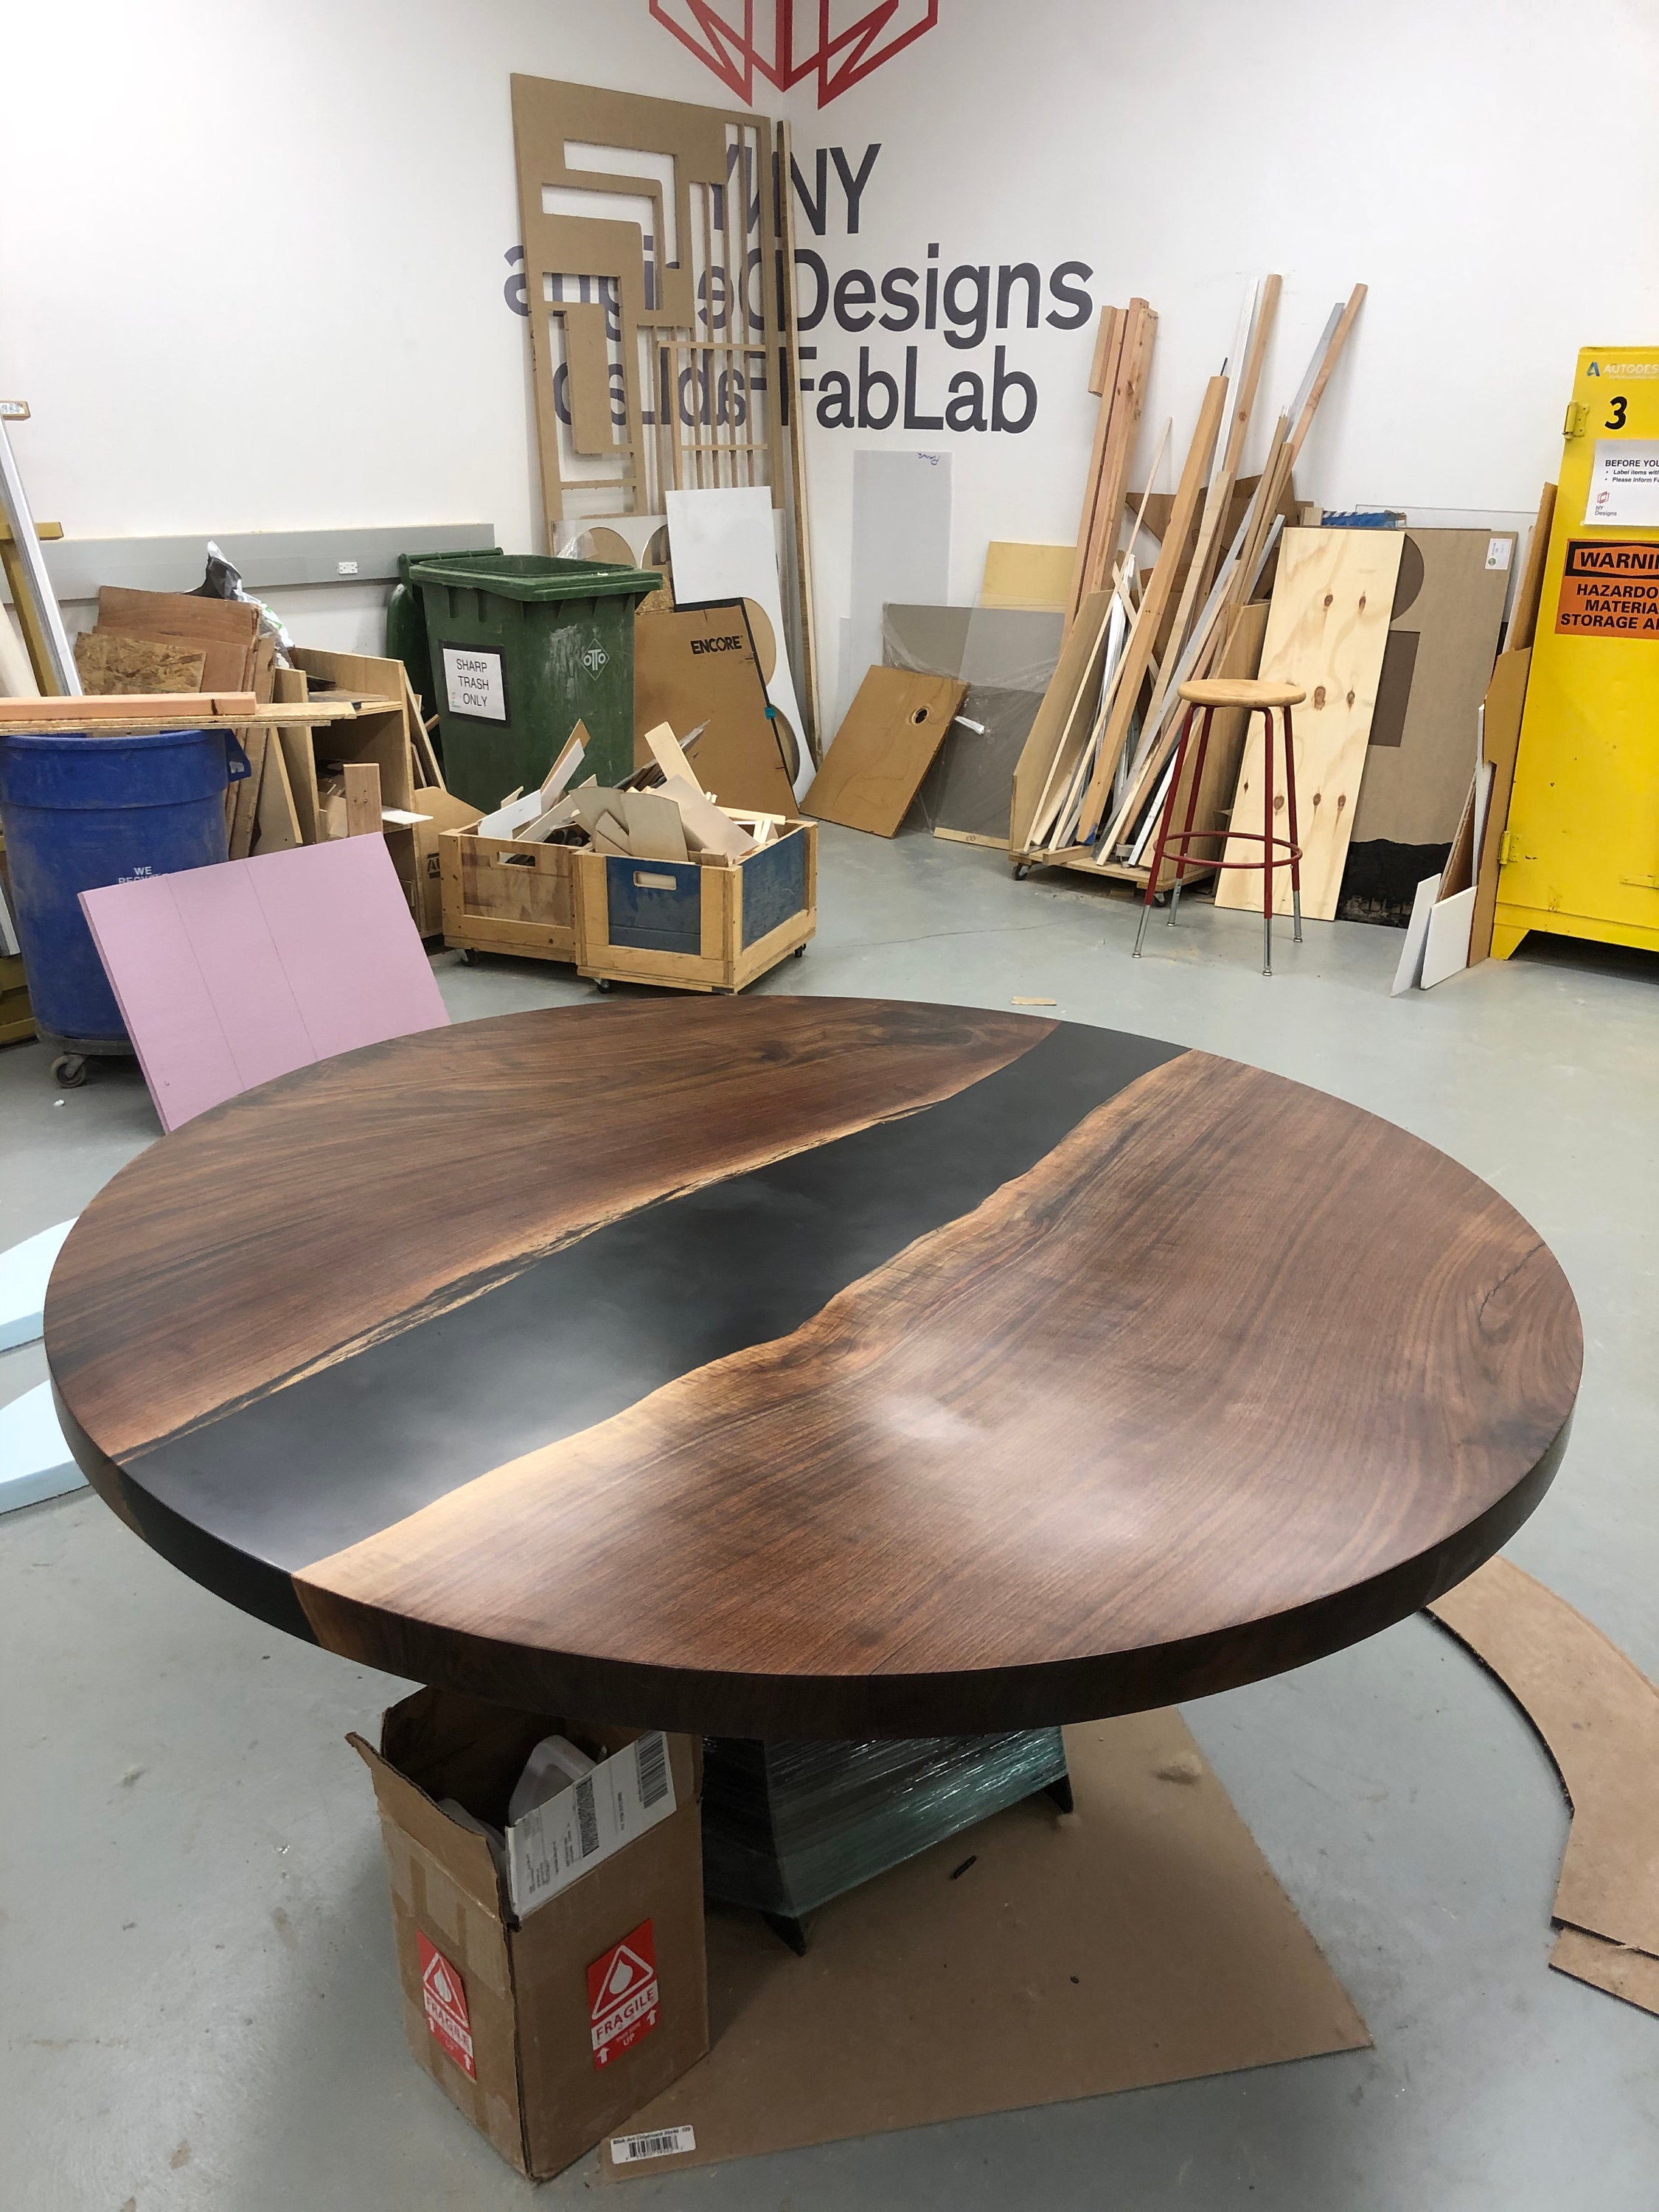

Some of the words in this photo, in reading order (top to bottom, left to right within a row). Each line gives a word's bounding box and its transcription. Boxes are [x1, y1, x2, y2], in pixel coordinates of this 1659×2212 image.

[773, 143, 882, 236] NY
[775, 243, 1094, 349] Designs
[779, 345, 1038, 434] FabLab
[1604, 396, 1628, 430] 3
[1576, 584, 1658, 599] HAZARDO
[1585, 599, 1658, 614] MATERIA
[1560, 613, 1638, 629] STORAGE
[690, 636, 742, 654] ENCORE
[456, 658, 487, 672] SHARP
[458, 675, 489, 690] TRASH
[463, 693, 487, 706] ONLY
[134, 866, 153, 875] WE
[596, 1987, 655, 2041] FRAGILE
